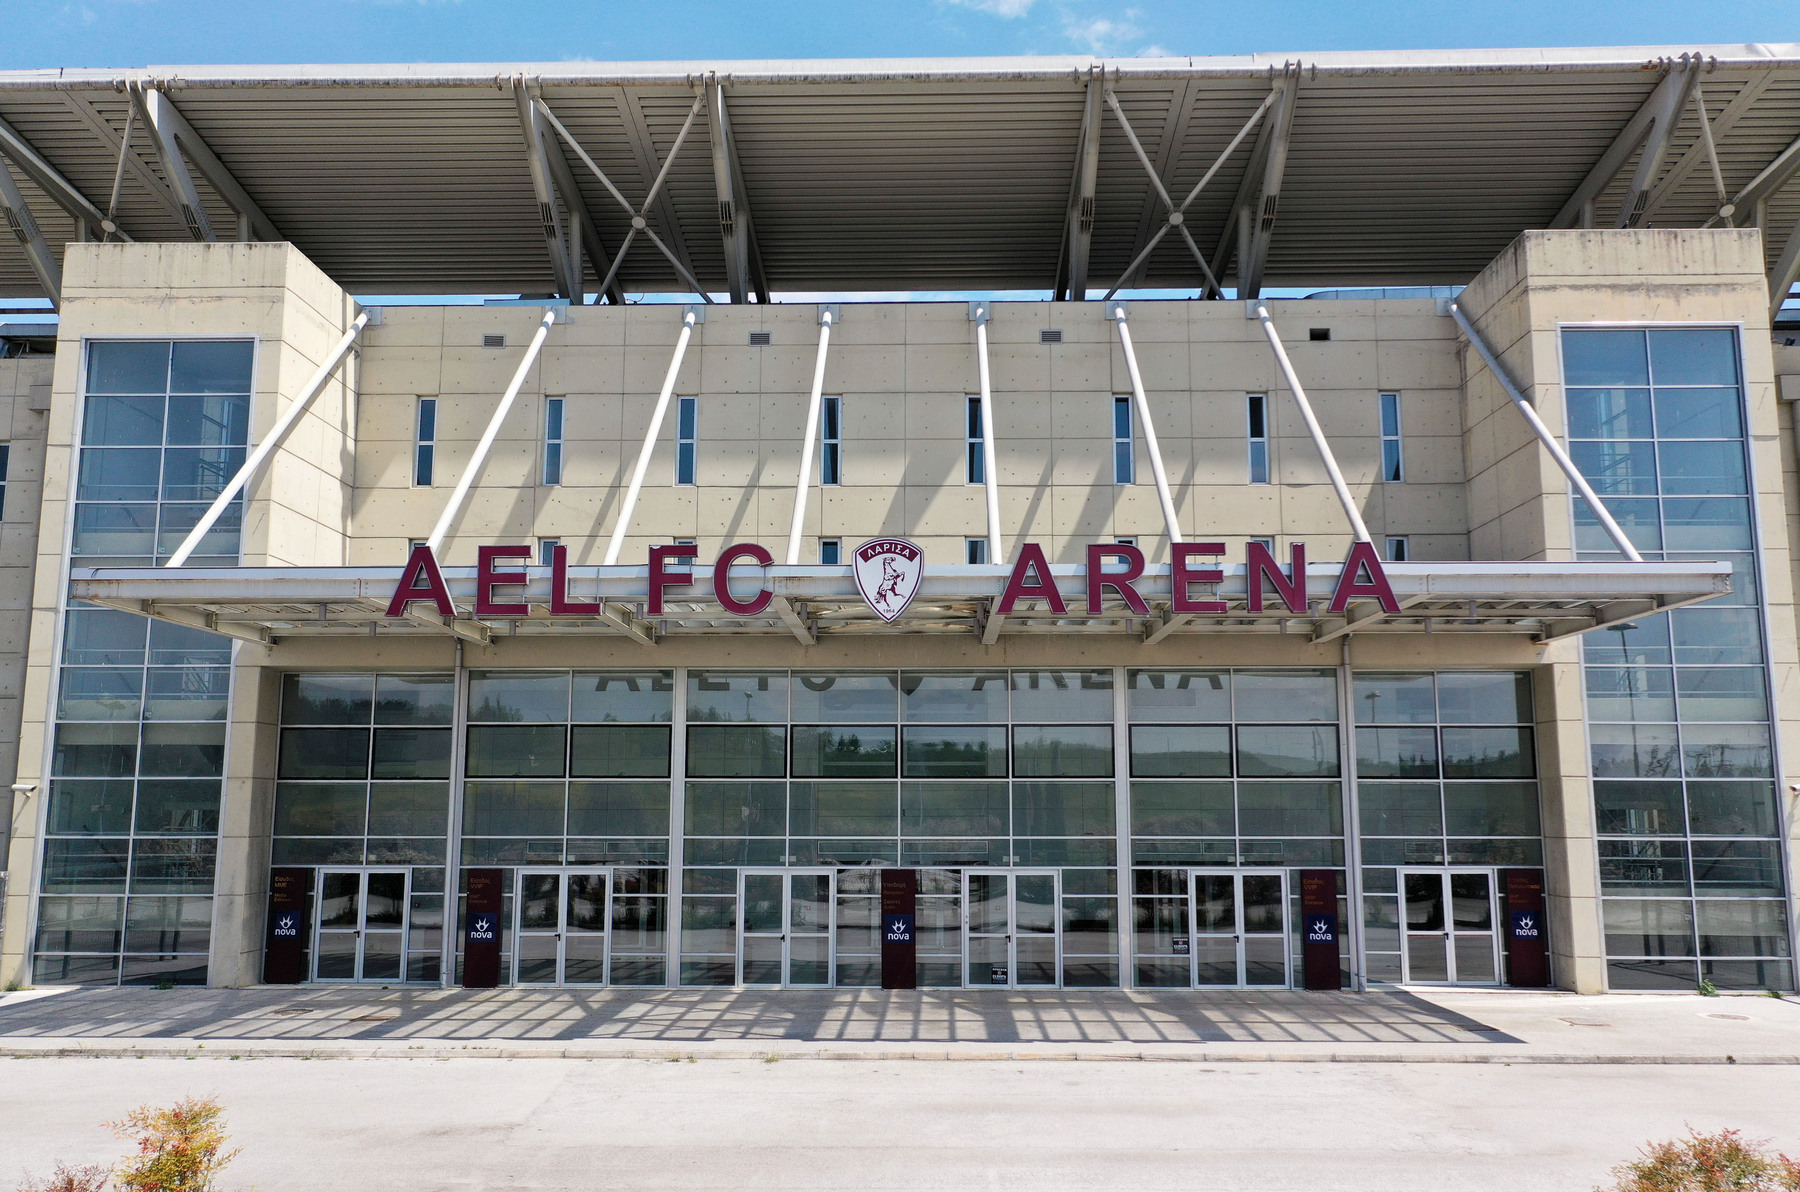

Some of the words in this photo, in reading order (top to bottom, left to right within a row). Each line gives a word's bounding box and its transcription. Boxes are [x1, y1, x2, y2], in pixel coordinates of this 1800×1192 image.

[867, 543, 910, 557] ΛΑΡΙΣΑ
[384, 544, 601, 618] AEL
[646, 542, 776, 617] FC
[995, 541, 1402, 616] ARENA
[274, 928, 296, 936] nova
[470, 931, 493, 939] nova
[1515, 928, 1538, 936] nova
